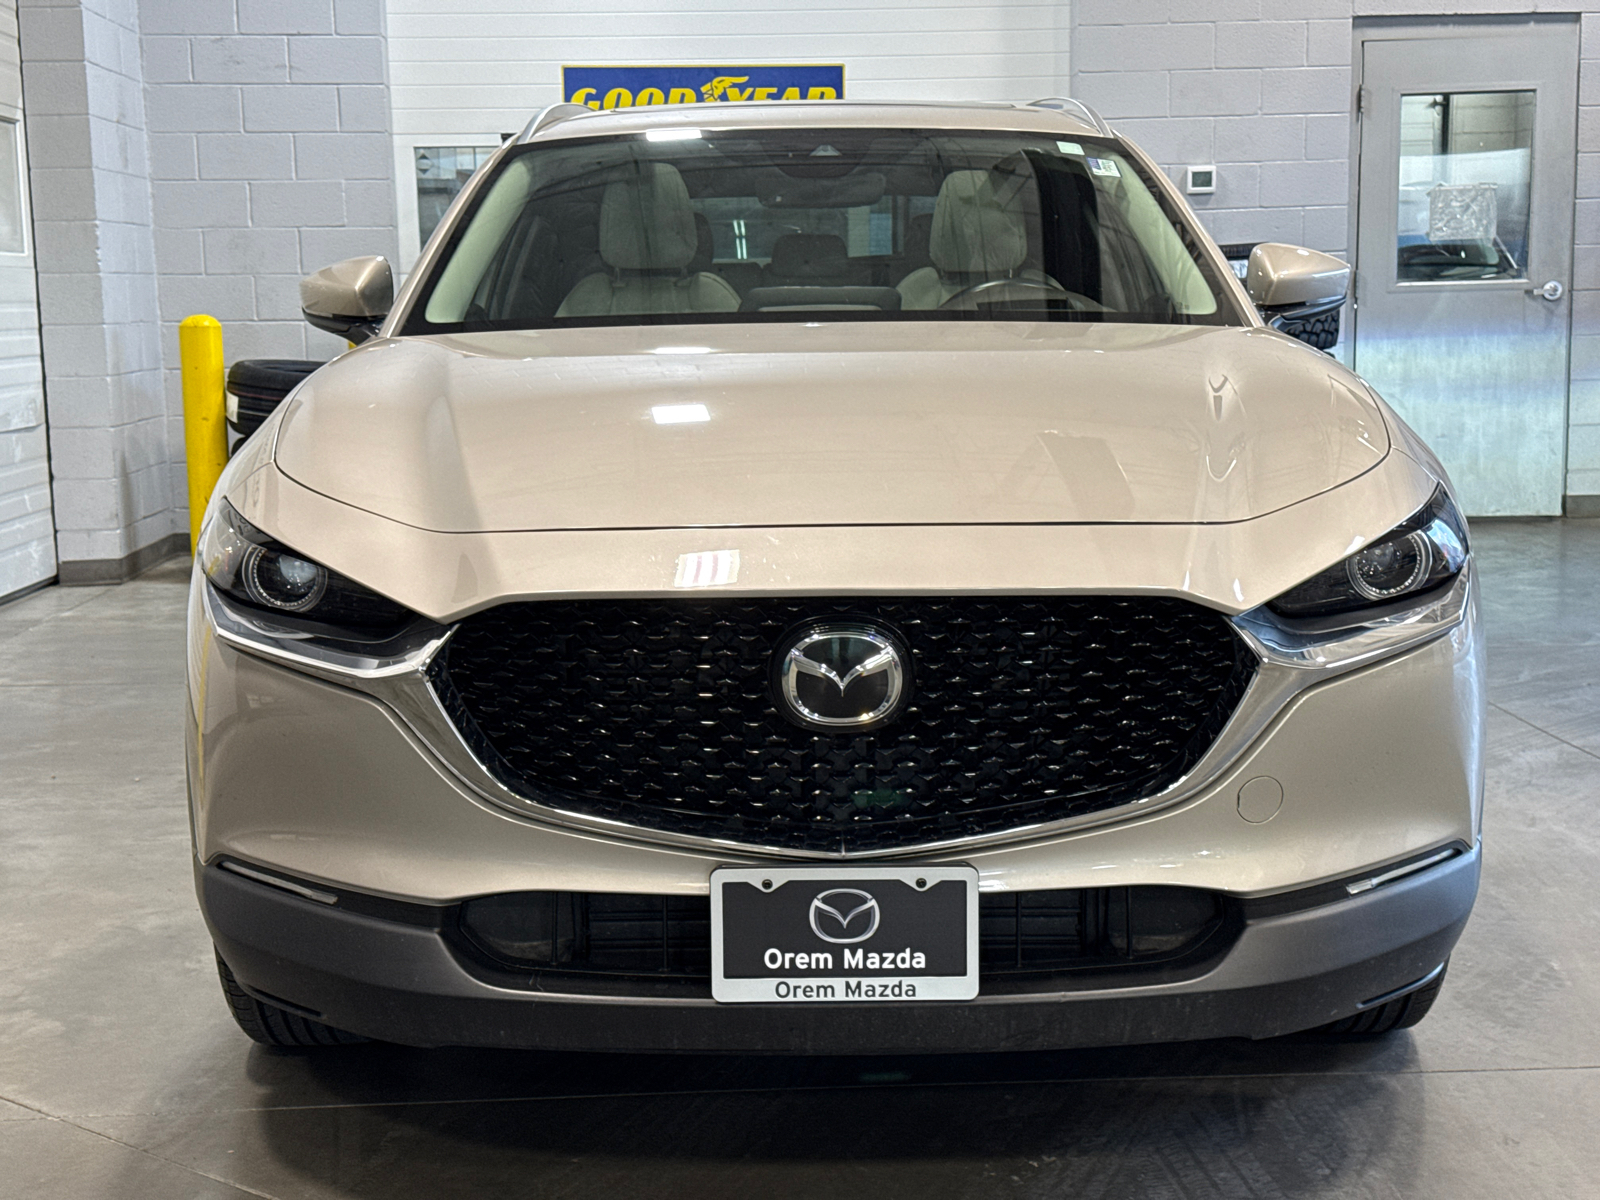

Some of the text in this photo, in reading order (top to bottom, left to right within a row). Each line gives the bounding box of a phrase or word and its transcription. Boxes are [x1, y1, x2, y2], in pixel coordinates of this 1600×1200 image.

[764, 947, 926, 970] Orem Mazda
[775, 980, 917, 999] Orem Mazda
